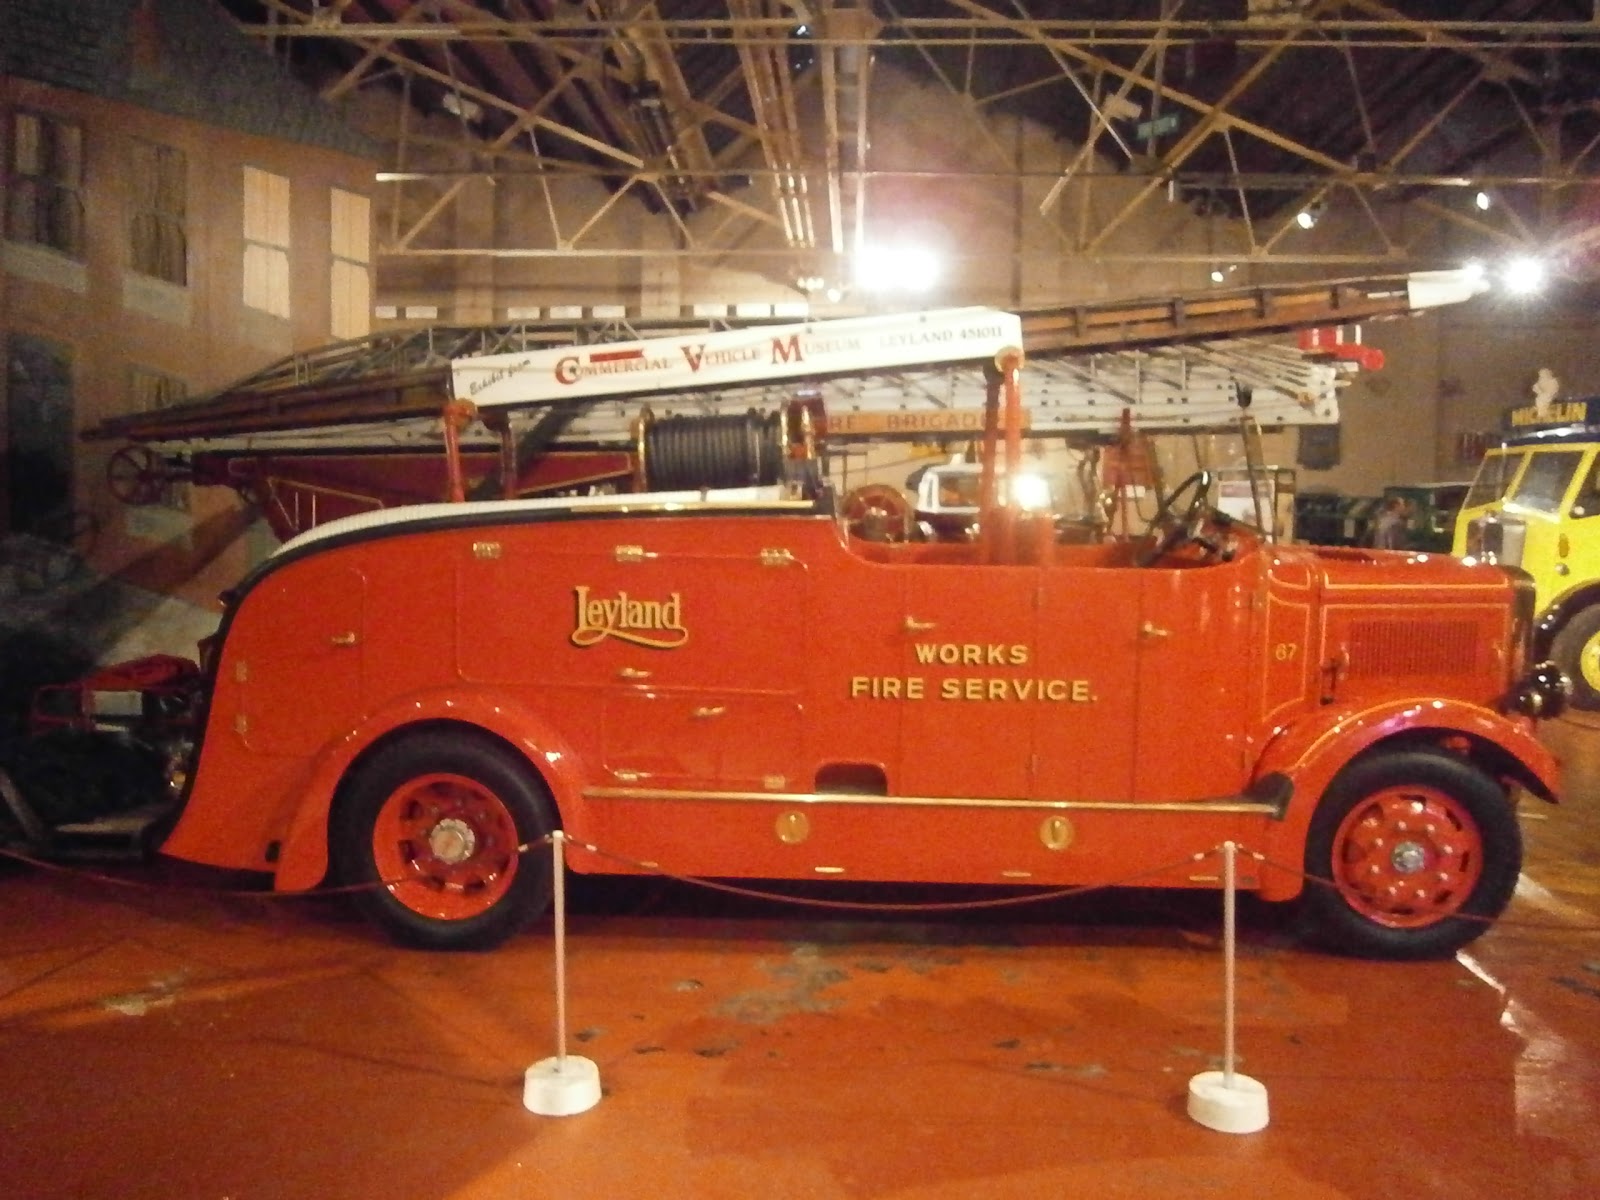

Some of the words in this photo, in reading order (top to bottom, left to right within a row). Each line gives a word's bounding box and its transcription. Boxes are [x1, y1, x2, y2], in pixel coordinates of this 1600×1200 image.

[879, 328, 953, 349] LEYLAND
[886, 412, 987, 430] BRIGAD
[571, 585, 689, 648] Leyland
[914, 642, 1030, 665] WORKS
[1275, 642, 1297, 661] 67
[851, 676, 925, 699] FIRE
